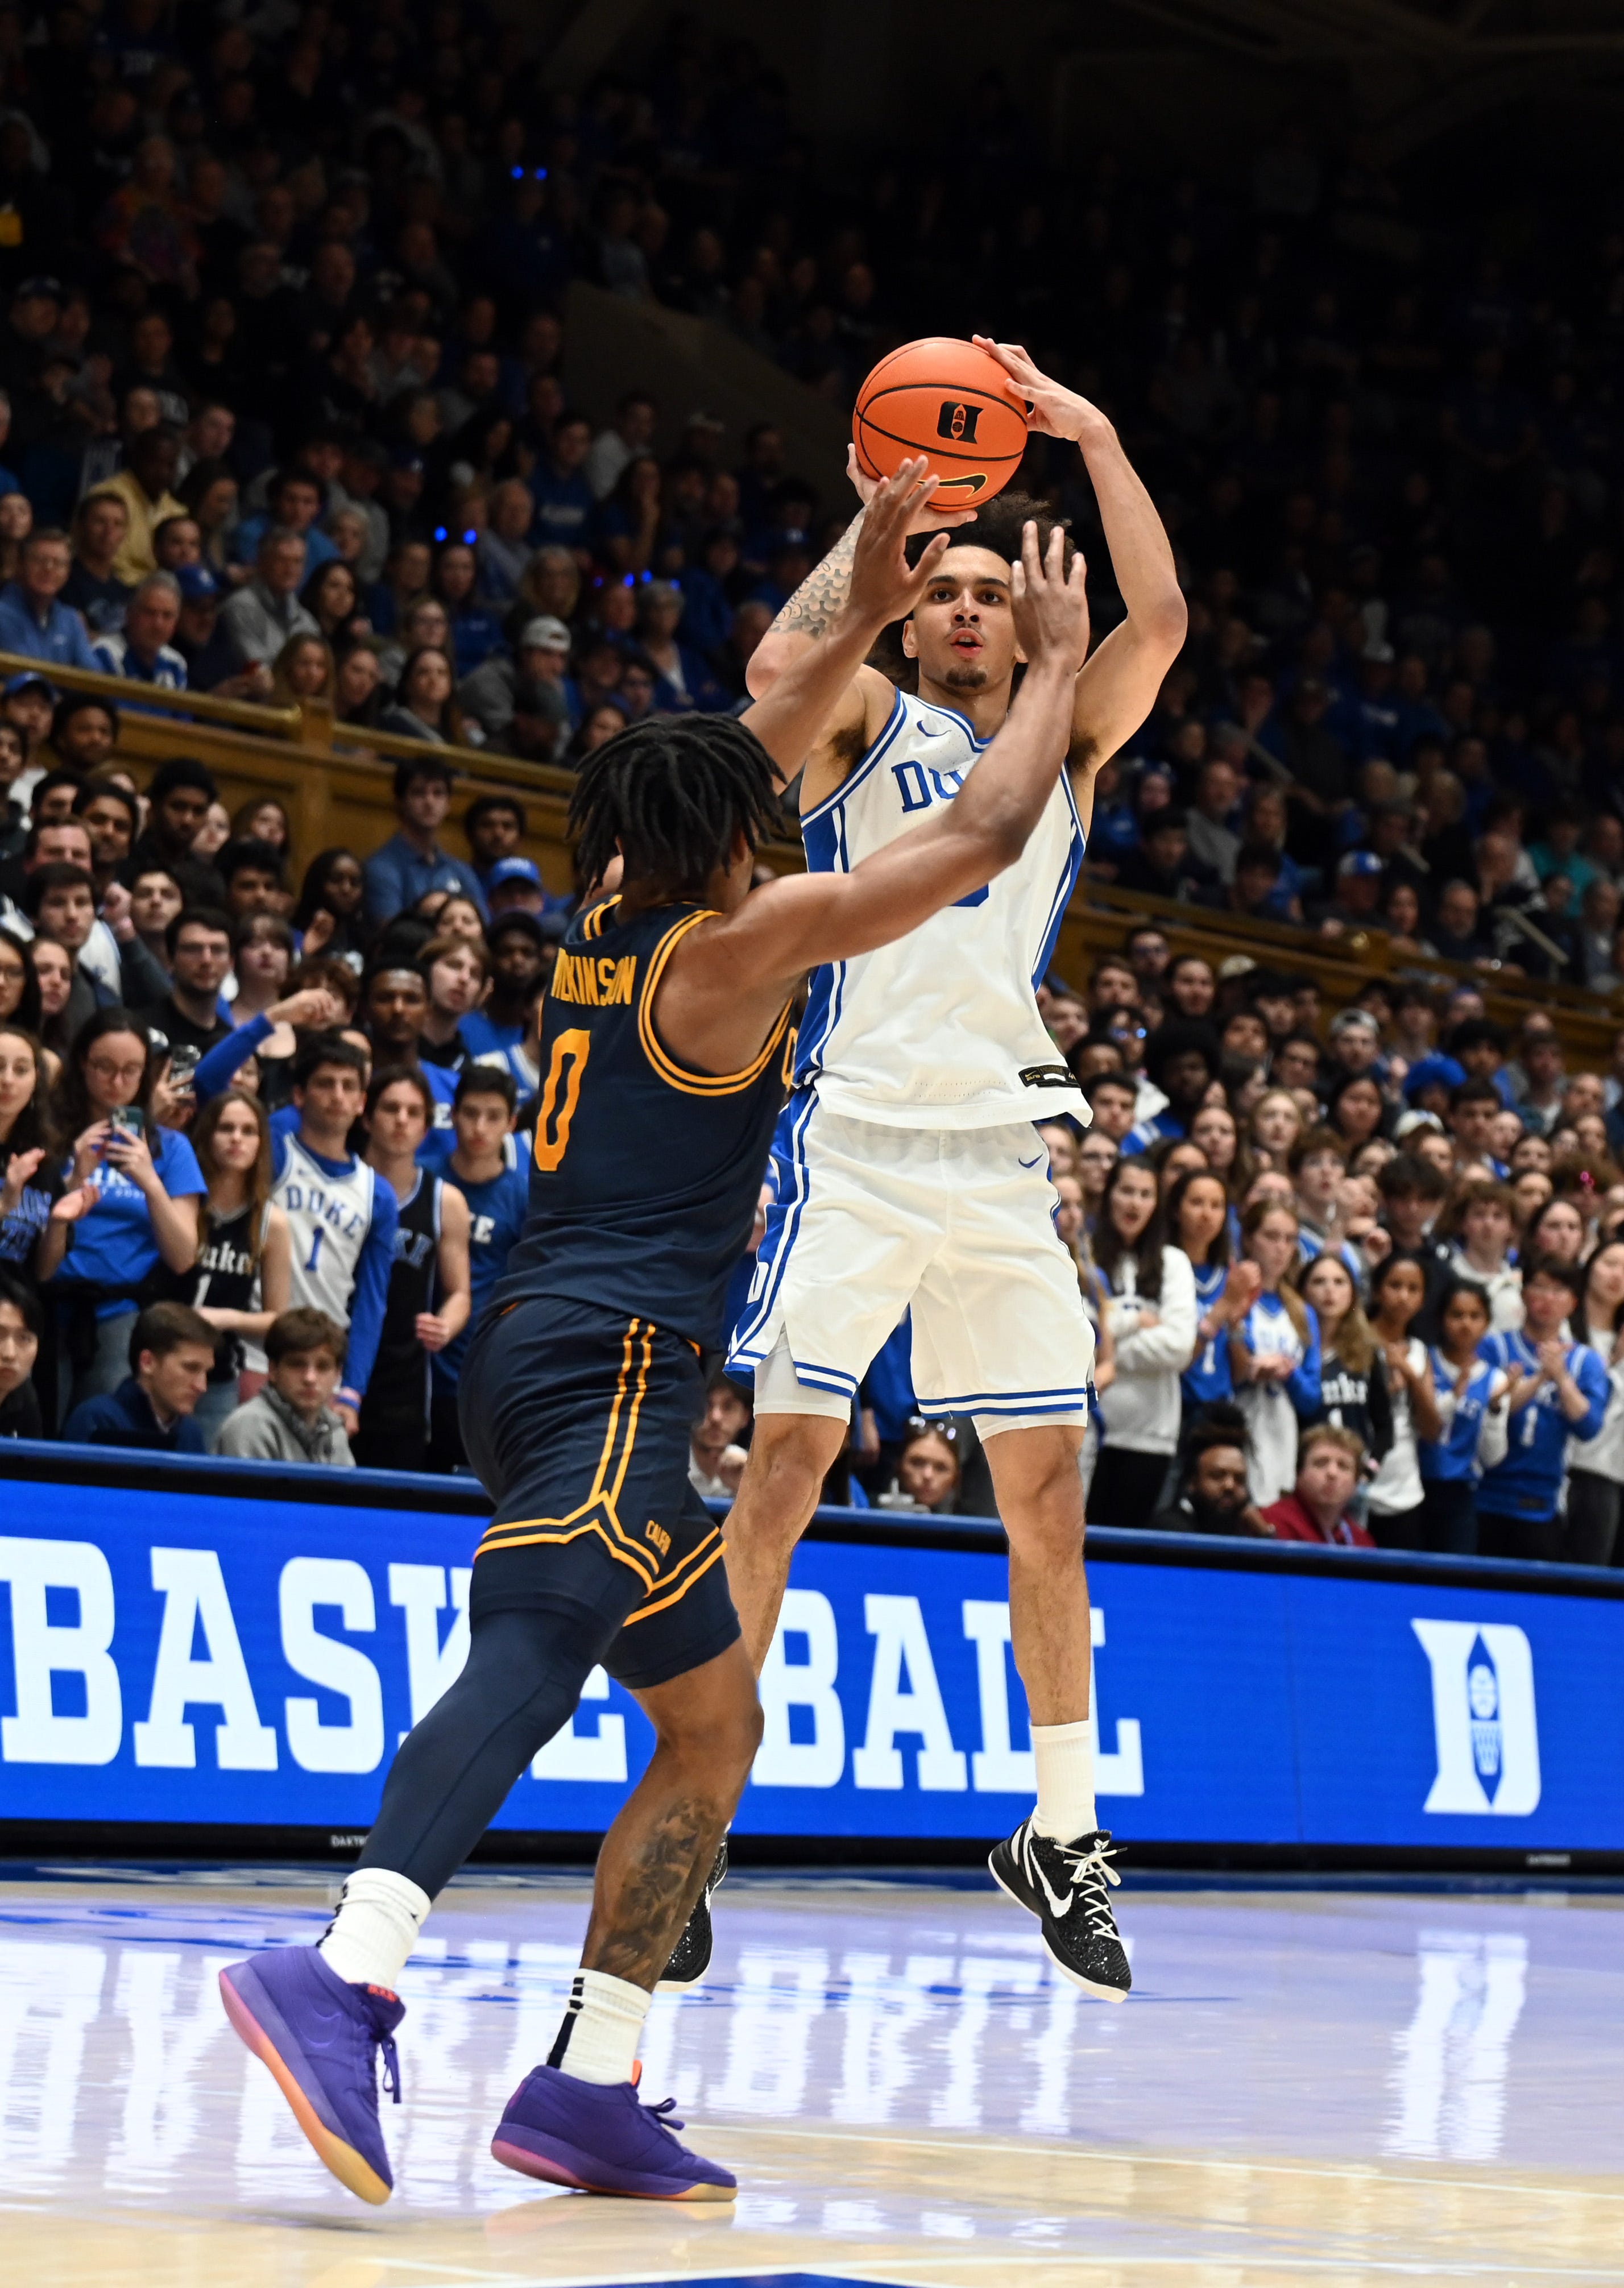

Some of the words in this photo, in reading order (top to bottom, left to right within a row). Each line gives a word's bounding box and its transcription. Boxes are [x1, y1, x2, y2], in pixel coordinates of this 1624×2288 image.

[891, 760, 966, 814] DU
[534, 1028, 590, 1171] 0
[286, 1186, 363, 1239] DUKE
[305, 1225, 324, 1271] 1
[1521, 1405, 1538, 1446] 1
[0, 1536, 1145, 1797] BASKBALL
